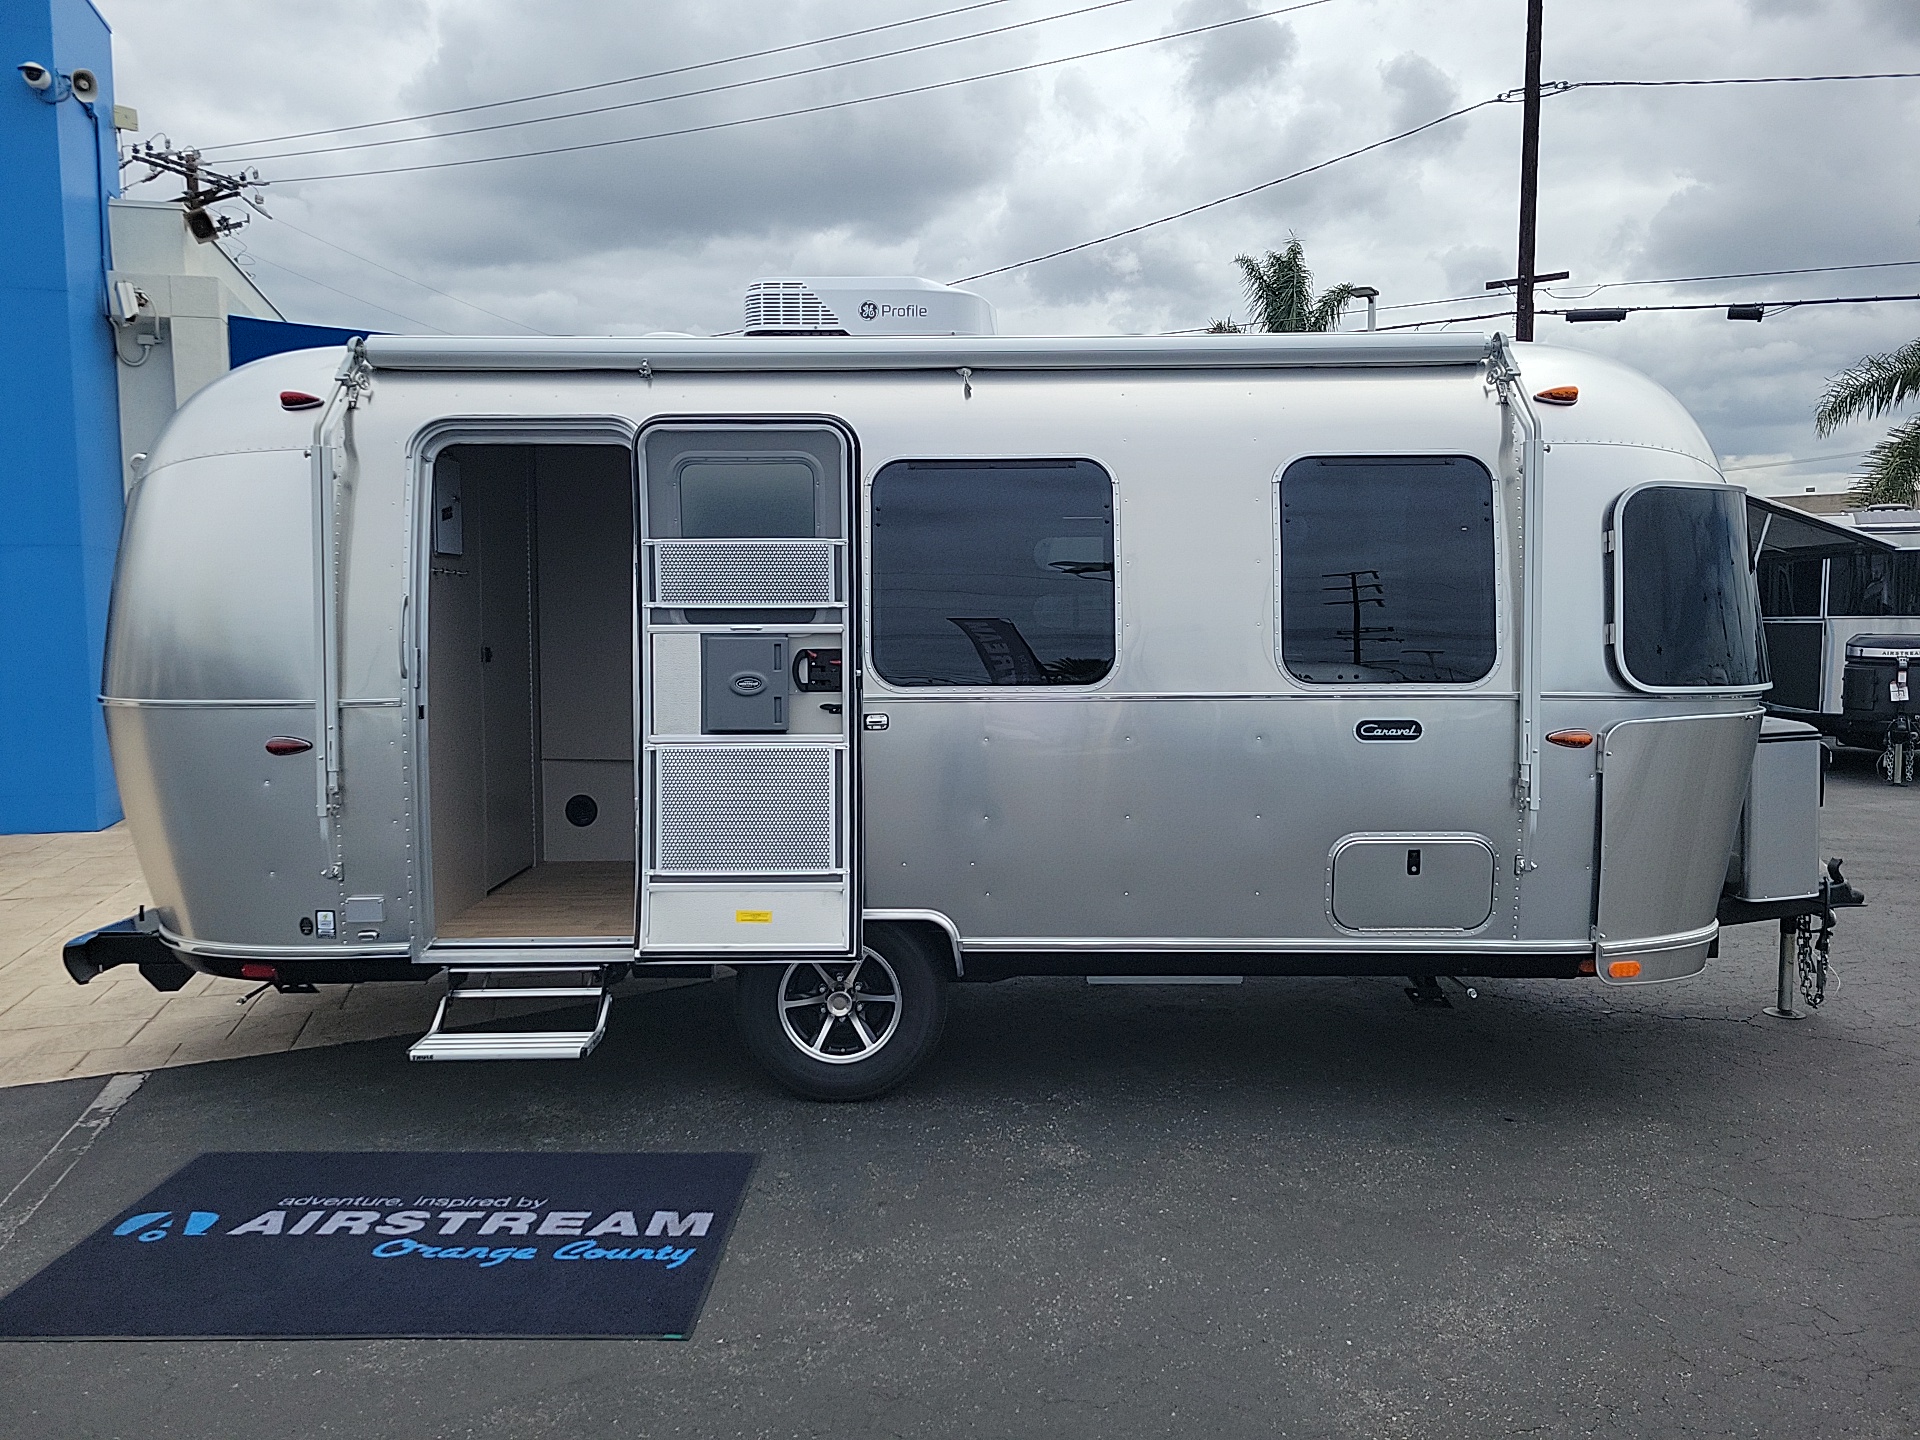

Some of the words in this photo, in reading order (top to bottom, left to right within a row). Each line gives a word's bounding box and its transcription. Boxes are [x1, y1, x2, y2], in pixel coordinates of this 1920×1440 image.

[881, 304, 928, 317] Profile
[1360, 724, 1420, 736] Caravel
[412, 1195, 510, 1209] inspired
[515, 1195, 549, 1209] by
[225, 1210, 714, 1237] AIRSTREAM
[371, 1238, 538, 1268] Orange
[552, 1239, 697, 1270] County
